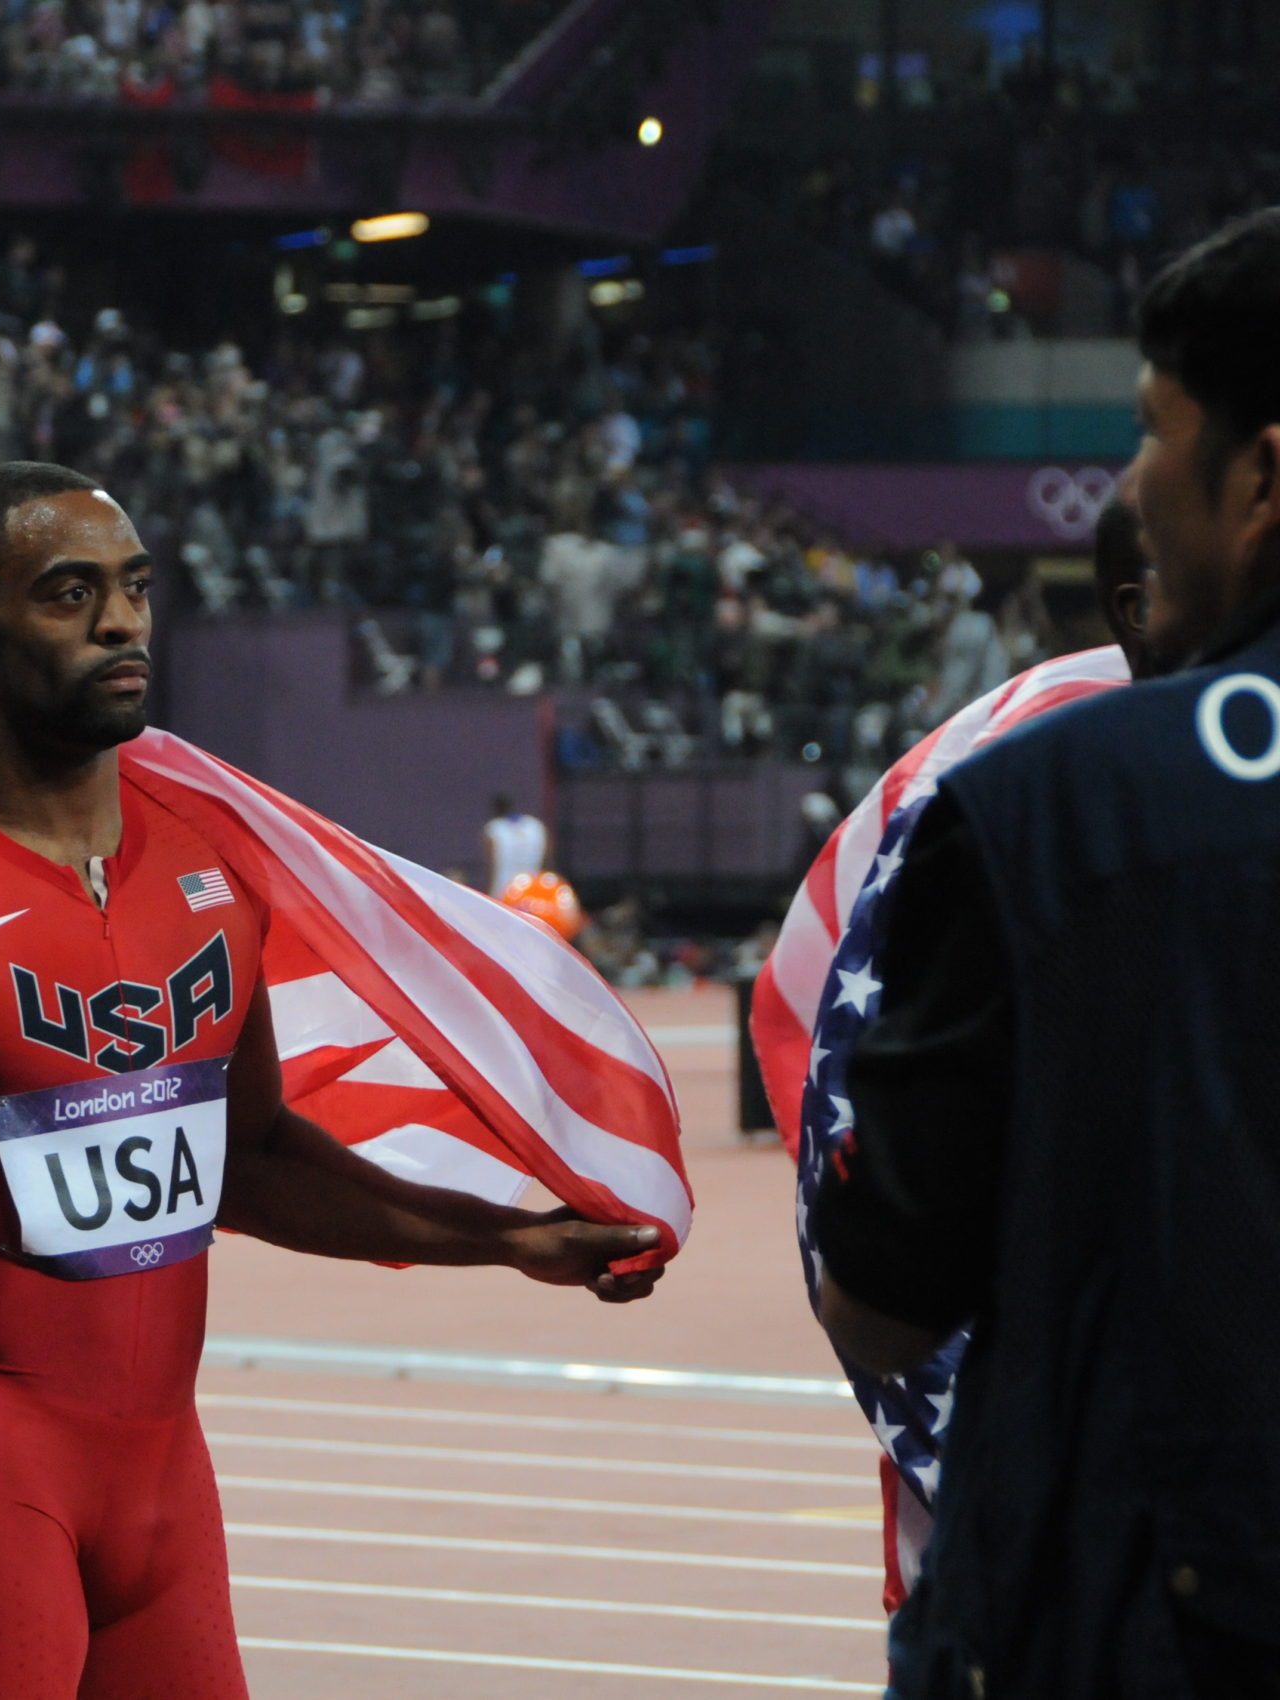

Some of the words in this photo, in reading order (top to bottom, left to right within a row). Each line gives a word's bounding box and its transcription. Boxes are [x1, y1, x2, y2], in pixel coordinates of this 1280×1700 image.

[9, 928, 233, 1075] USA
[54, 1088, 135, 1121] London
[140, 1077, 182, 1104] 2012
[43, 1126, 204, 1231] USA
